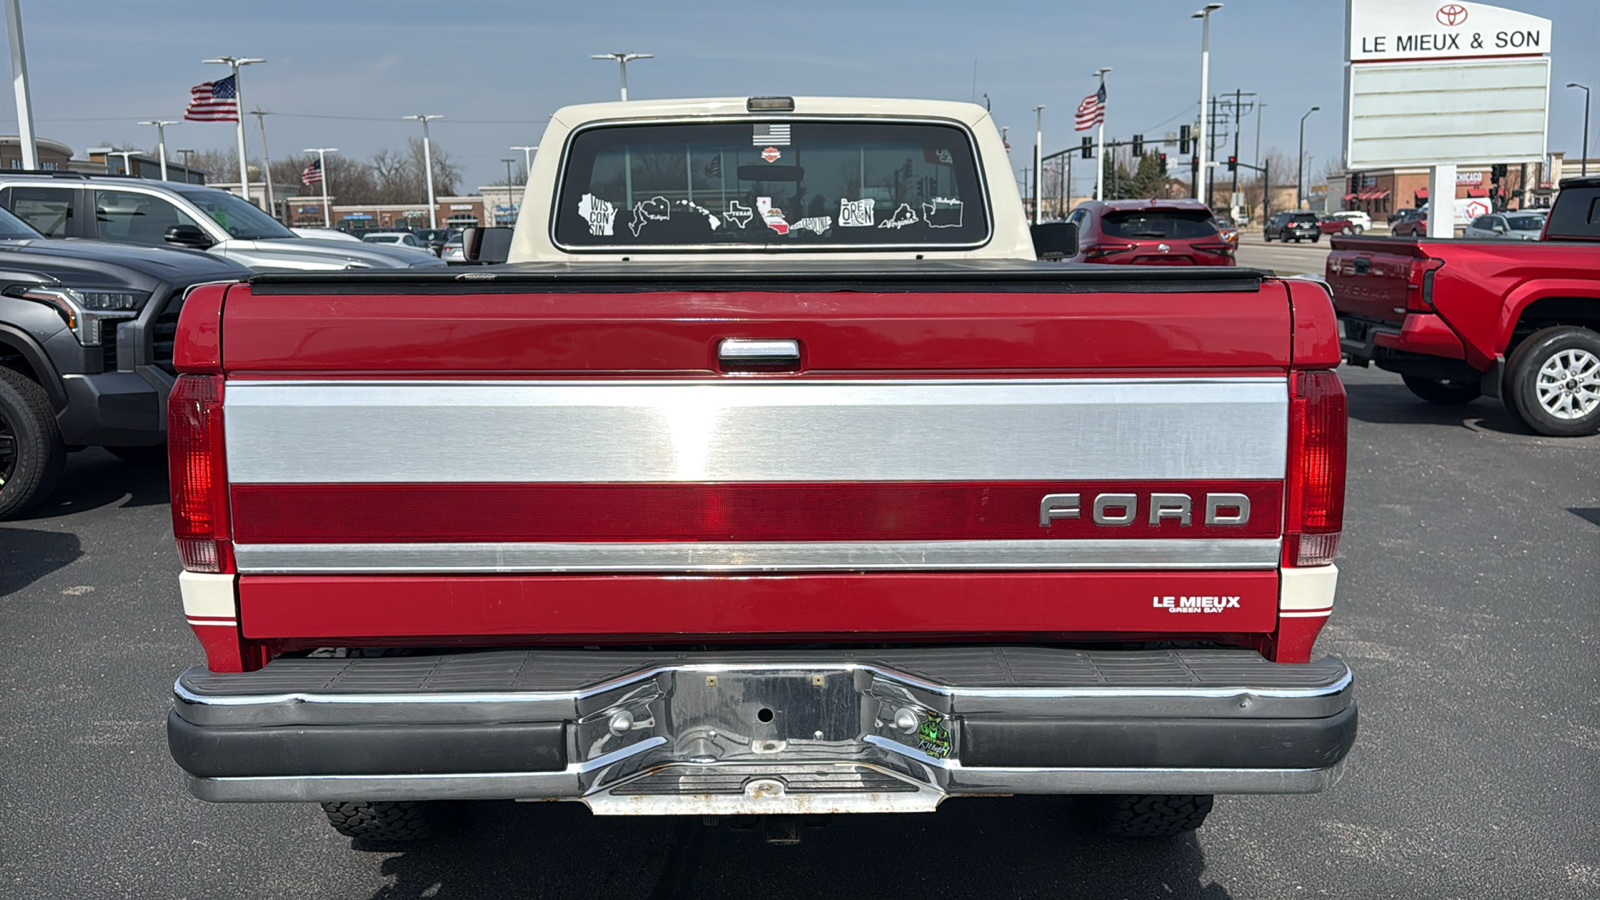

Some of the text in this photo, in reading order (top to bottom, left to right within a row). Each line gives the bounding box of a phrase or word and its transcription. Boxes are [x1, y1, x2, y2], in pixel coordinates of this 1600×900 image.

[1362, 30, 1541, 53] LE MIEUX & SON
[590, 195, 609, 211] WIS
[590, 212, 609, 225] CON
[590, 224, 605, 236] SIN
[1038, 492, 1251, 527] FORD
[1153, 596, 1241, 608] LE MIEUX
